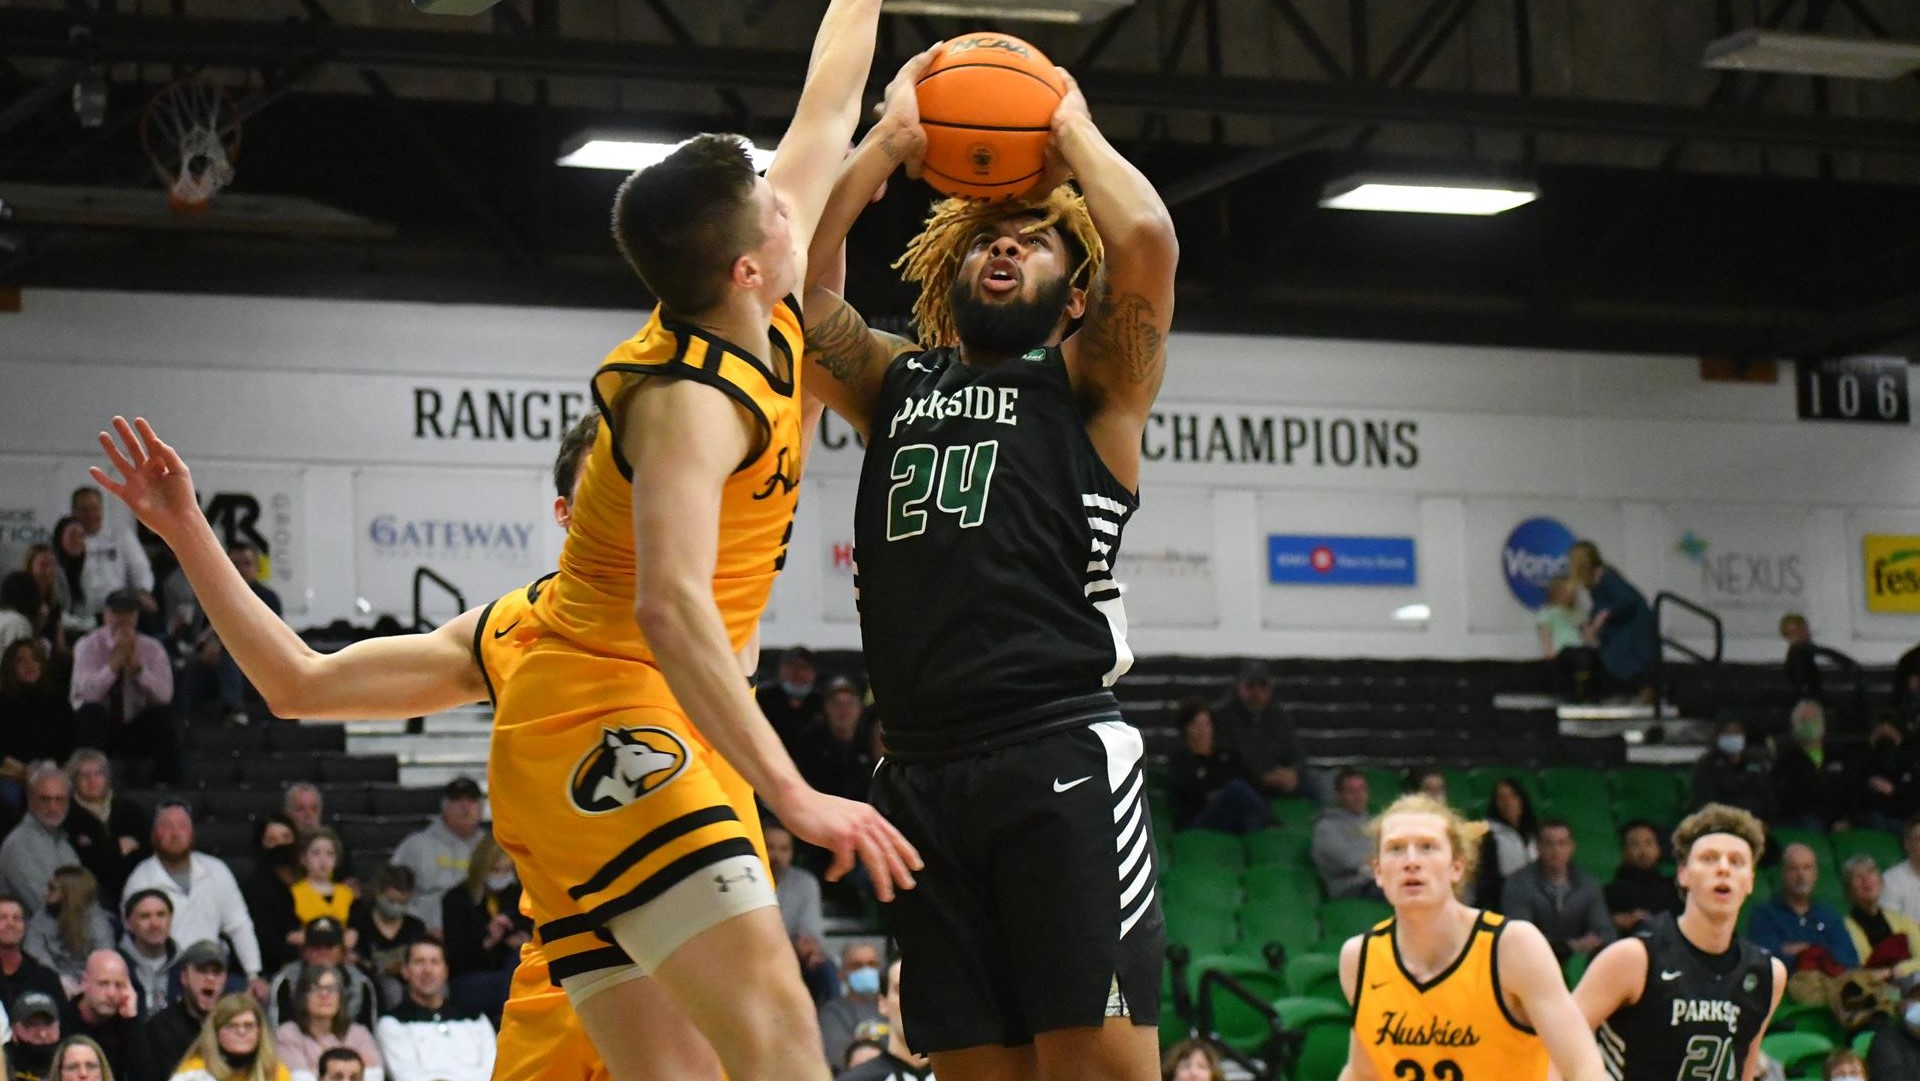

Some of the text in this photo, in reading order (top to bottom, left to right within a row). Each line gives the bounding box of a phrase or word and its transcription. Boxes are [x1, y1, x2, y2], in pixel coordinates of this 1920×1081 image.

[946, 37, 1031, 58] NCAA
[887, 385, 1019, 439] PAKSIDE
[1810, 371, 1899, 419] 106
[1141, 411, 1420, 469] CHAMPIONS
[887, 440, 999, 542] 24
[369, 514, 534, 549] GATEWAY
[1702, 552, 1805, 596] NEXUS
[1374, 1011, 1481, 1047] Huskies
